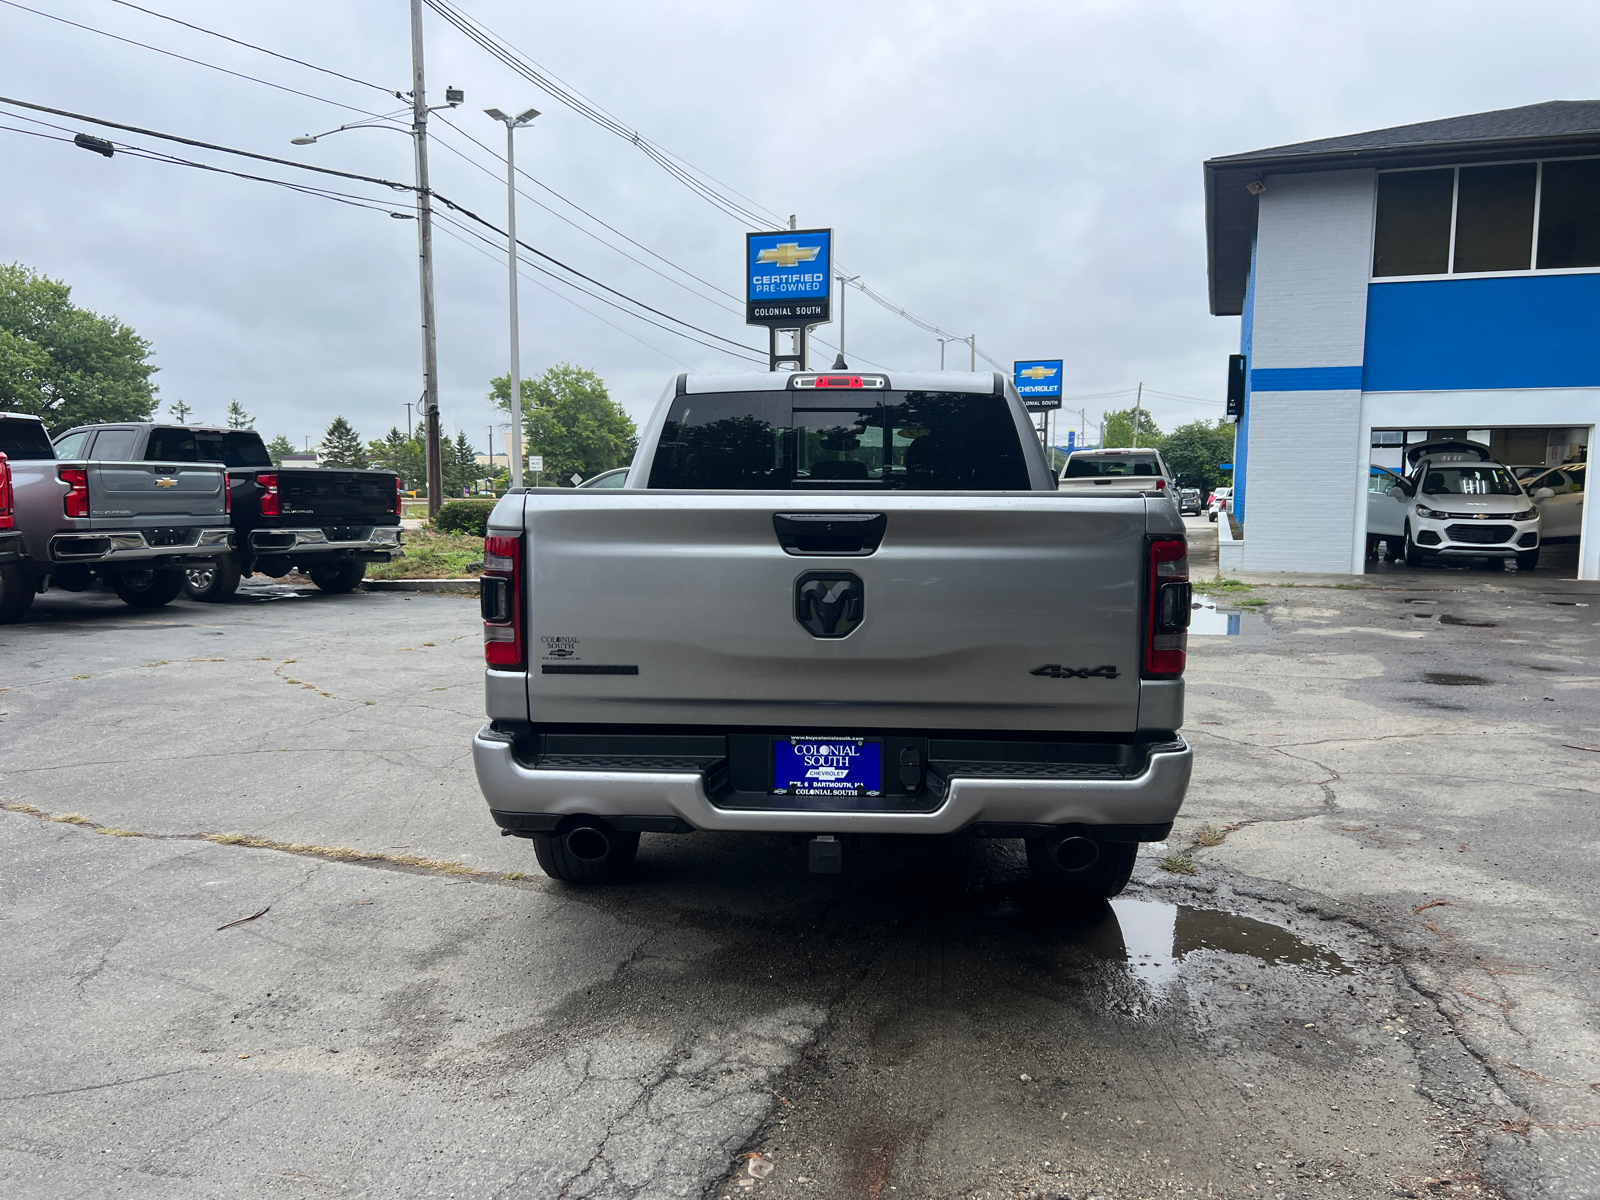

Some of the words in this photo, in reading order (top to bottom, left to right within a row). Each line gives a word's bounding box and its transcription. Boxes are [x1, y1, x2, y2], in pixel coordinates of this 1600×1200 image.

[753, 274, 823, 284] CERTIFIED
[756, 283, 820, 292] PRE-OWNED
[754, 308, 792, 316] COLONIAL
[795, 306, 821, 315] SOUTH
[794, 744, 860, 756] COLONIAL
[804, 755, 849, 767] SOUTH
[813, 781, 853, 789] DARTMOUTH,
[795, 788, 832, 796] COLONIAL
[833, 789, 858, 797] SOUTH
